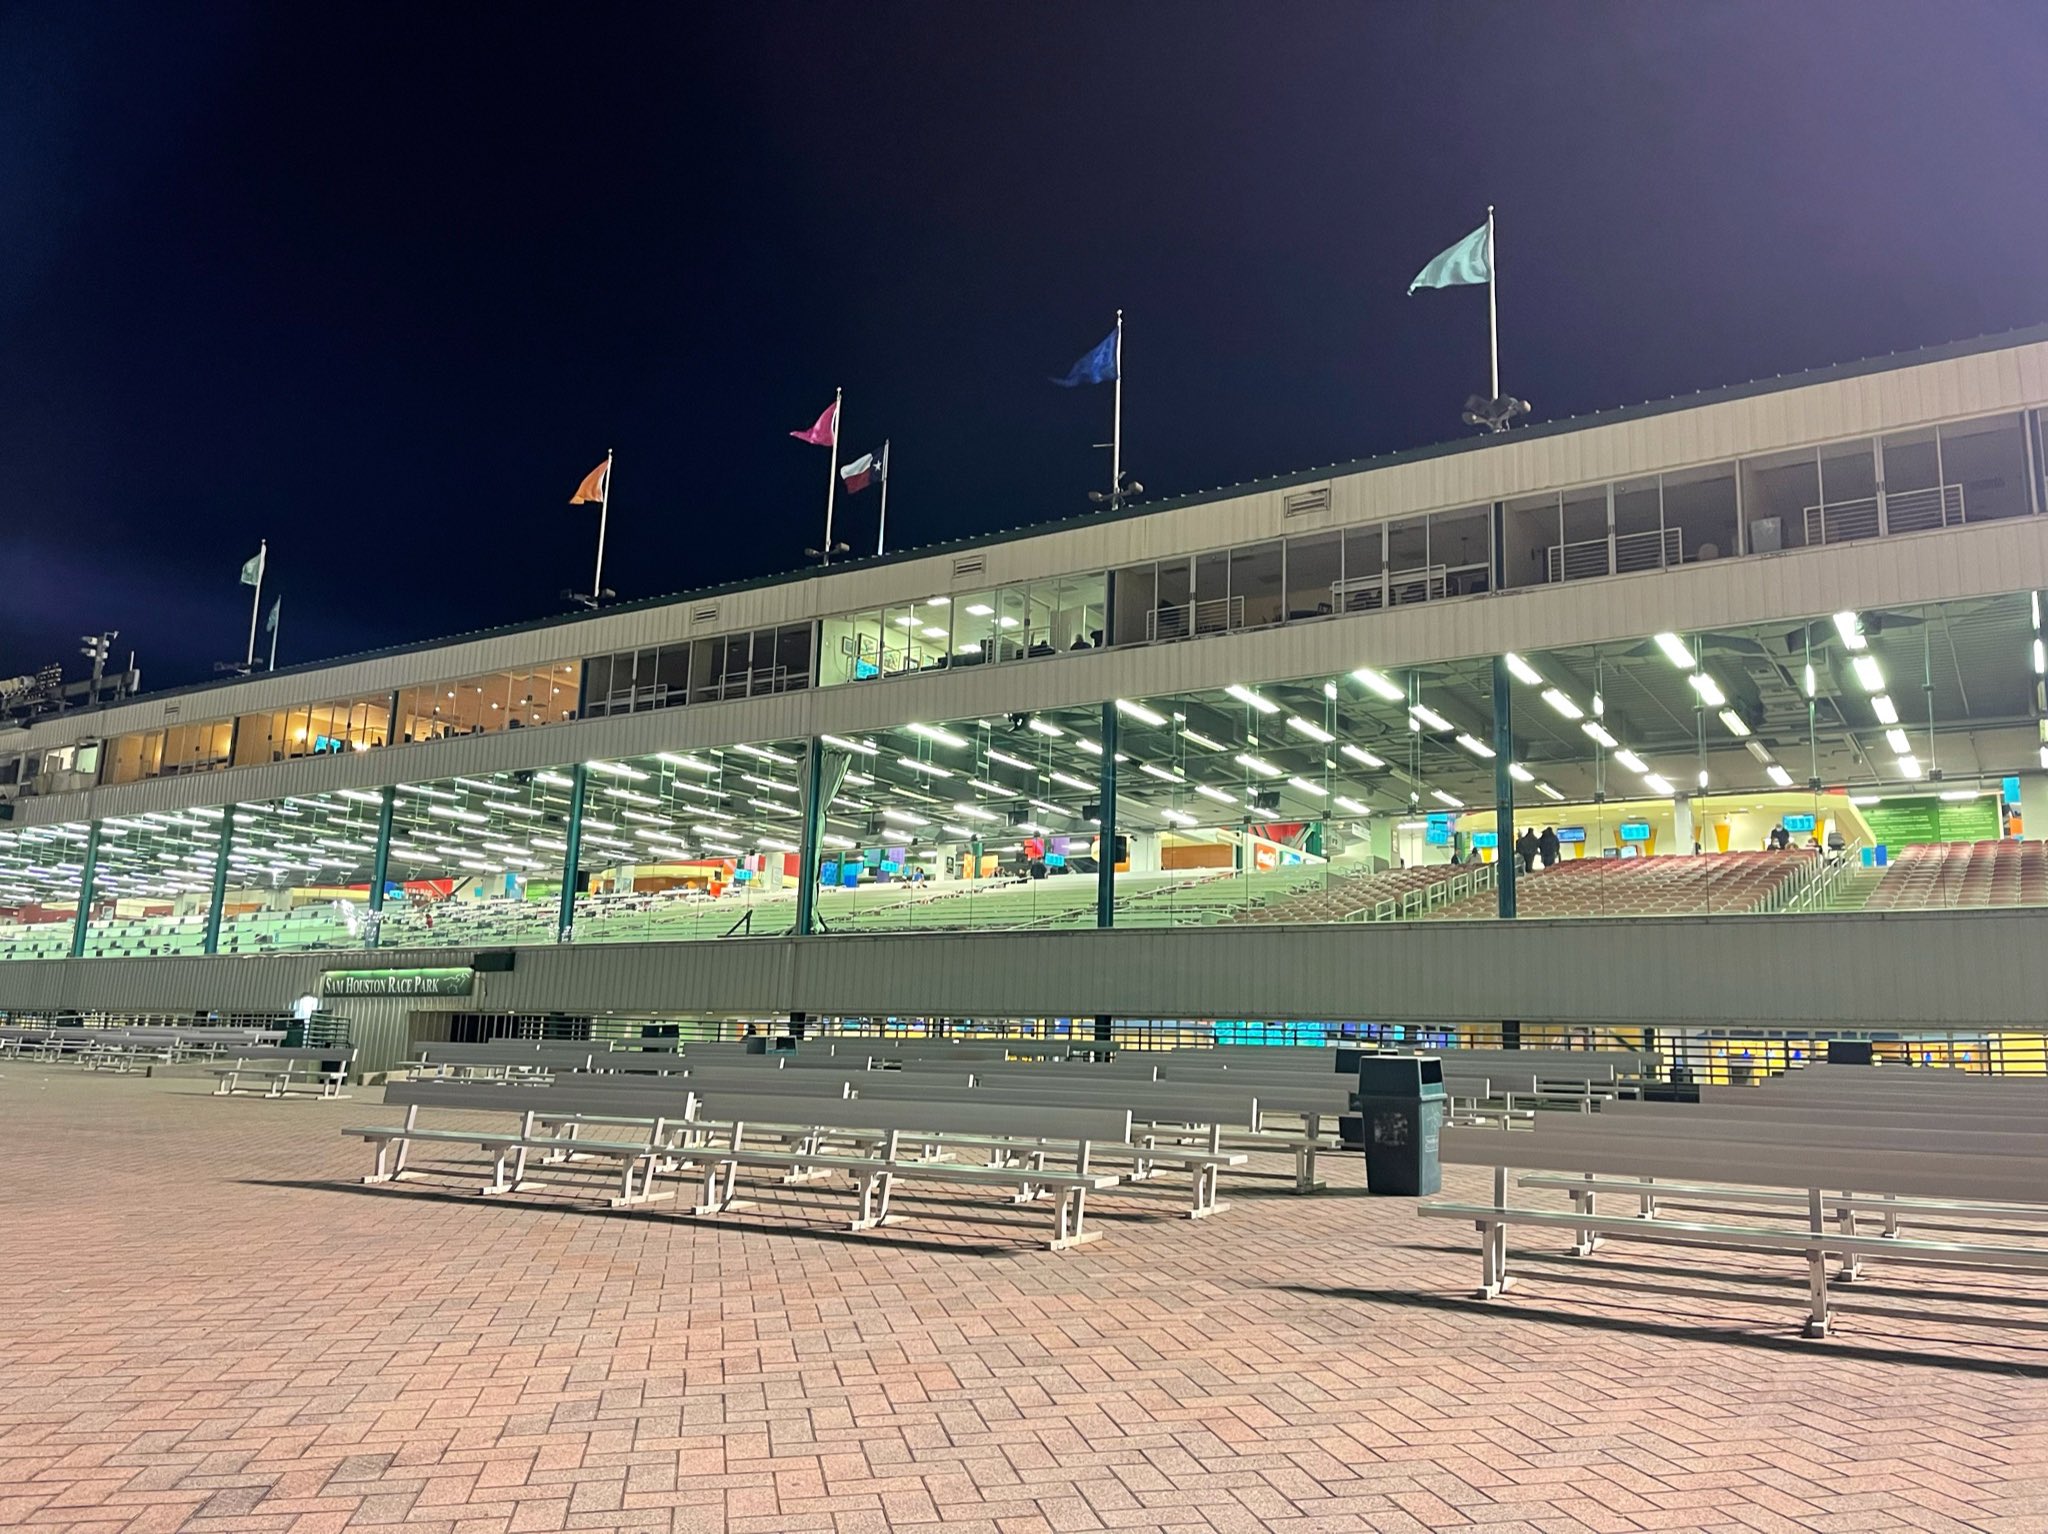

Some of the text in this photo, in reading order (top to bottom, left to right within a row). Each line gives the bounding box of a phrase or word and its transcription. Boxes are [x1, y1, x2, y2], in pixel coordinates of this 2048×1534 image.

[325, 975, 439, 993] SAM HOUSTON RACE PARK
